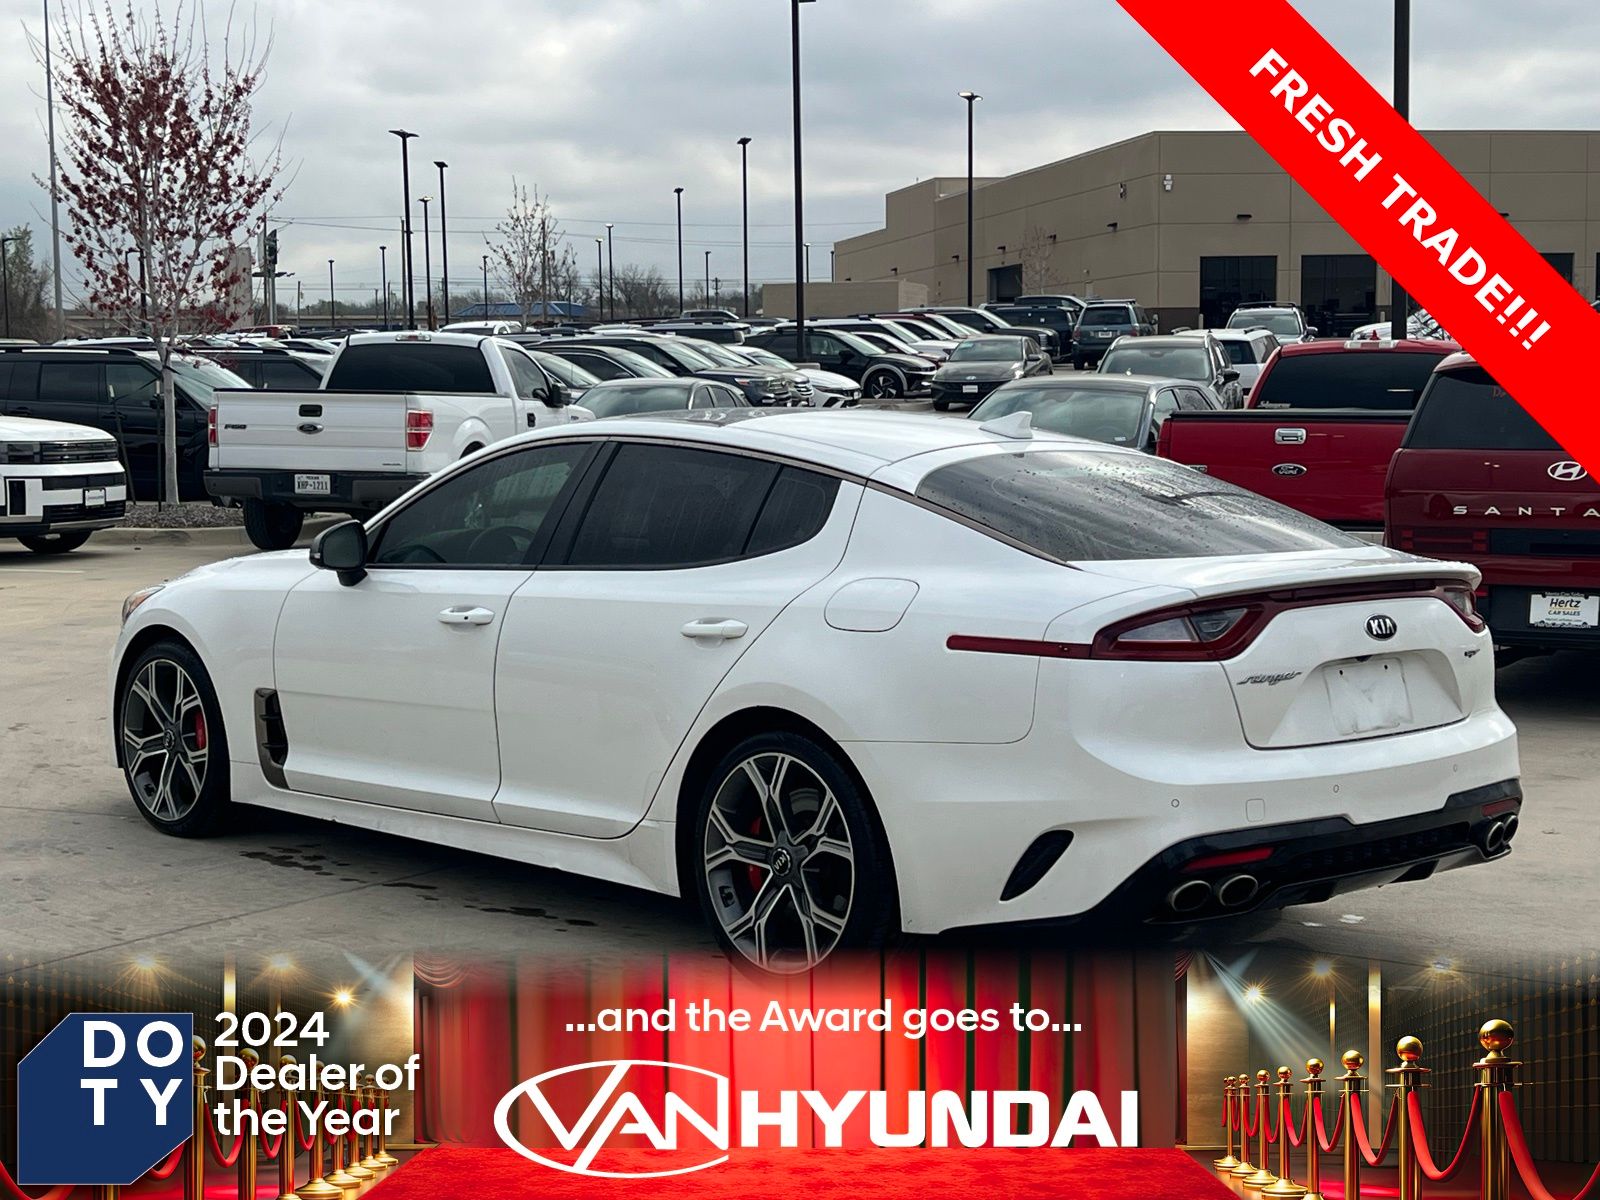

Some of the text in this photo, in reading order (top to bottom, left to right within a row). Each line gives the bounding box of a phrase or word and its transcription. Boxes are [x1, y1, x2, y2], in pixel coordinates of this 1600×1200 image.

[1453, 505, 1600, 518] SANTA
[1550, 598, 1581, 608] Hertz
[1369, 618, 1395, 635] KIA
[773, 854, 787, 871] KIA
